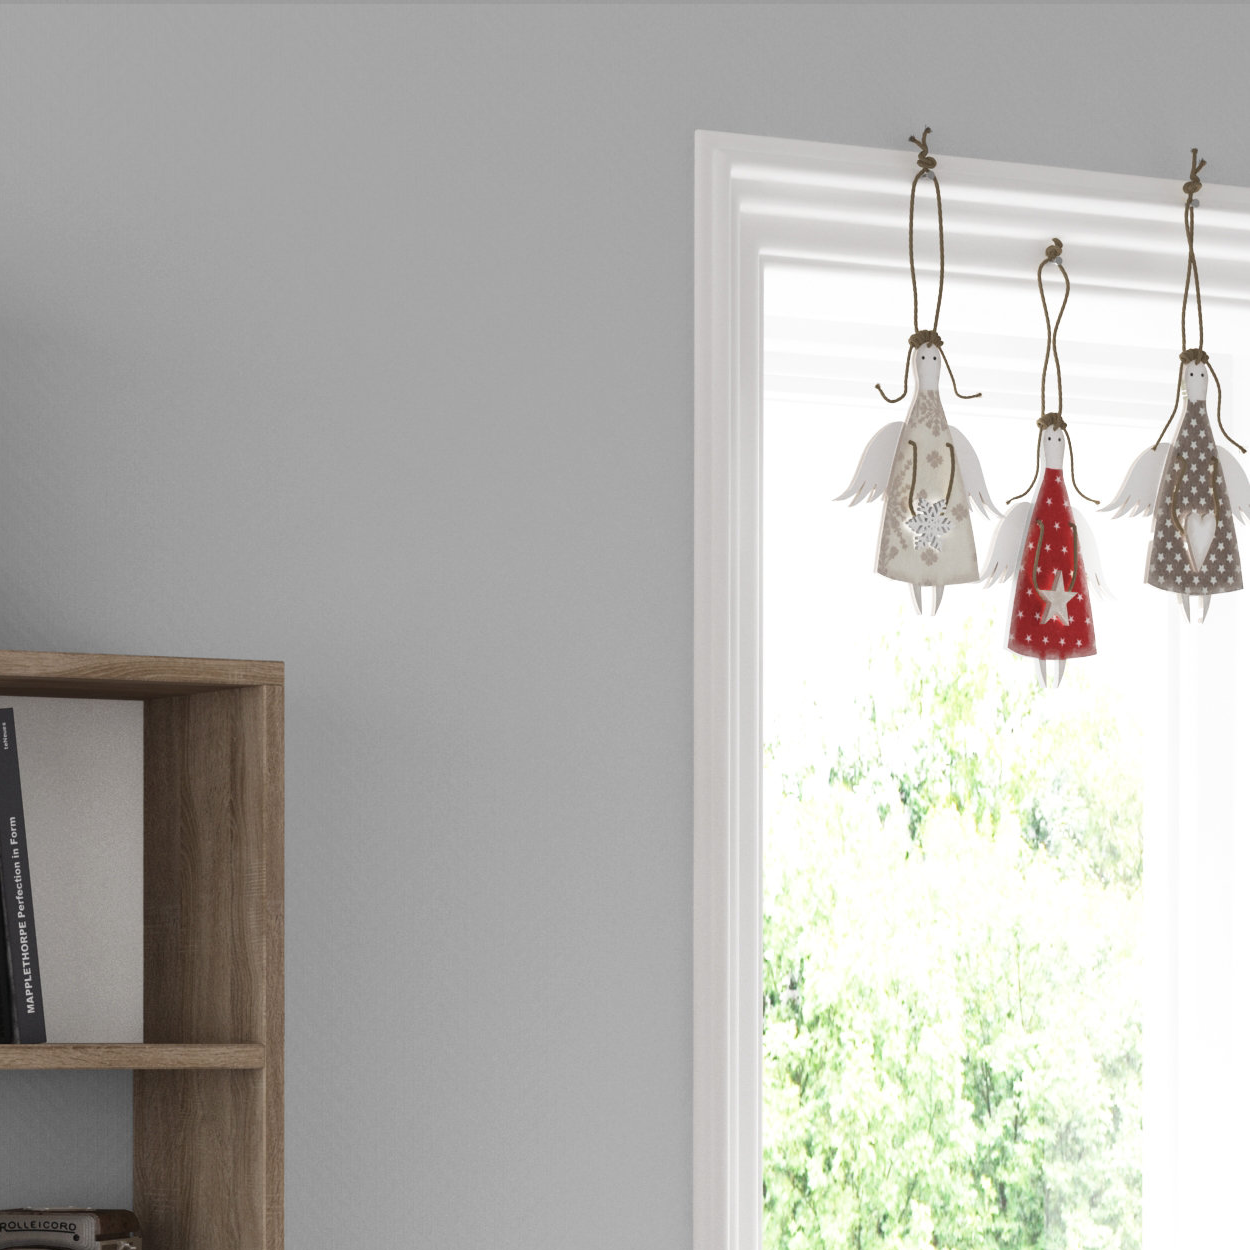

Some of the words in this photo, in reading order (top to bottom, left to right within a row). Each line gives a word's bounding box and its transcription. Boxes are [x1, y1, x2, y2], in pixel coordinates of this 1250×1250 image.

[10, 817, 18, 845] Form
[12, 848, 20, 859] in
[14, 862, 27, 918] Perfection
[19, 921, 35, 1014] MAPPLETHORPE
[0, 1221, 76, 1233] ROLLEICORD
